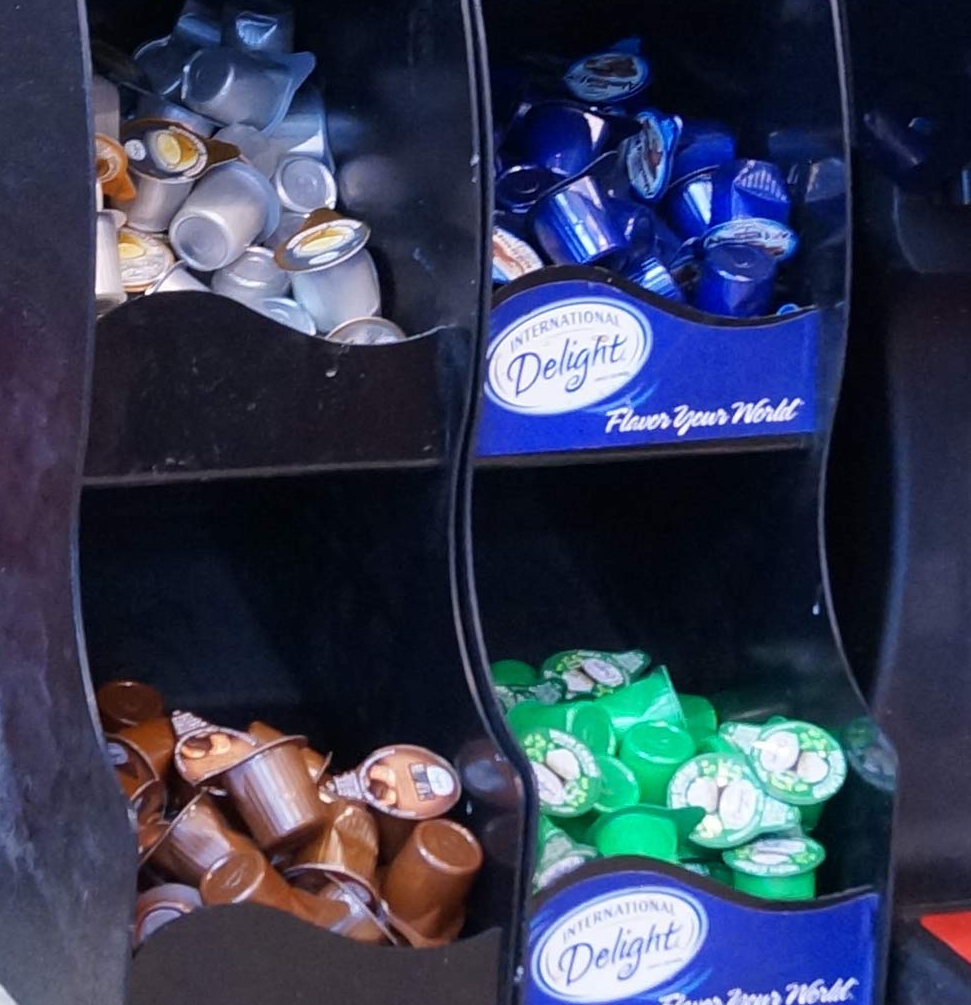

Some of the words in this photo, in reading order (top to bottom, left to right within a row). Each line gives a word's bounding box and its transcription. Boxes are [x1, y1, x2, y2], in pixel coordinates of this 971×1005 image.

[509, 310, 623, 352] INTERNATIONAL
[506, 335, 627, 393] Delight
[604, 407, 673, 434] Flavor
[673, 405, 730, 436] Your
[730, 397, 801, 424] World
[561, 899, 676, 942] INTERNATIONAL
[558, 922, 682, 986] Delight
[785, 977, 859, 1005] World
